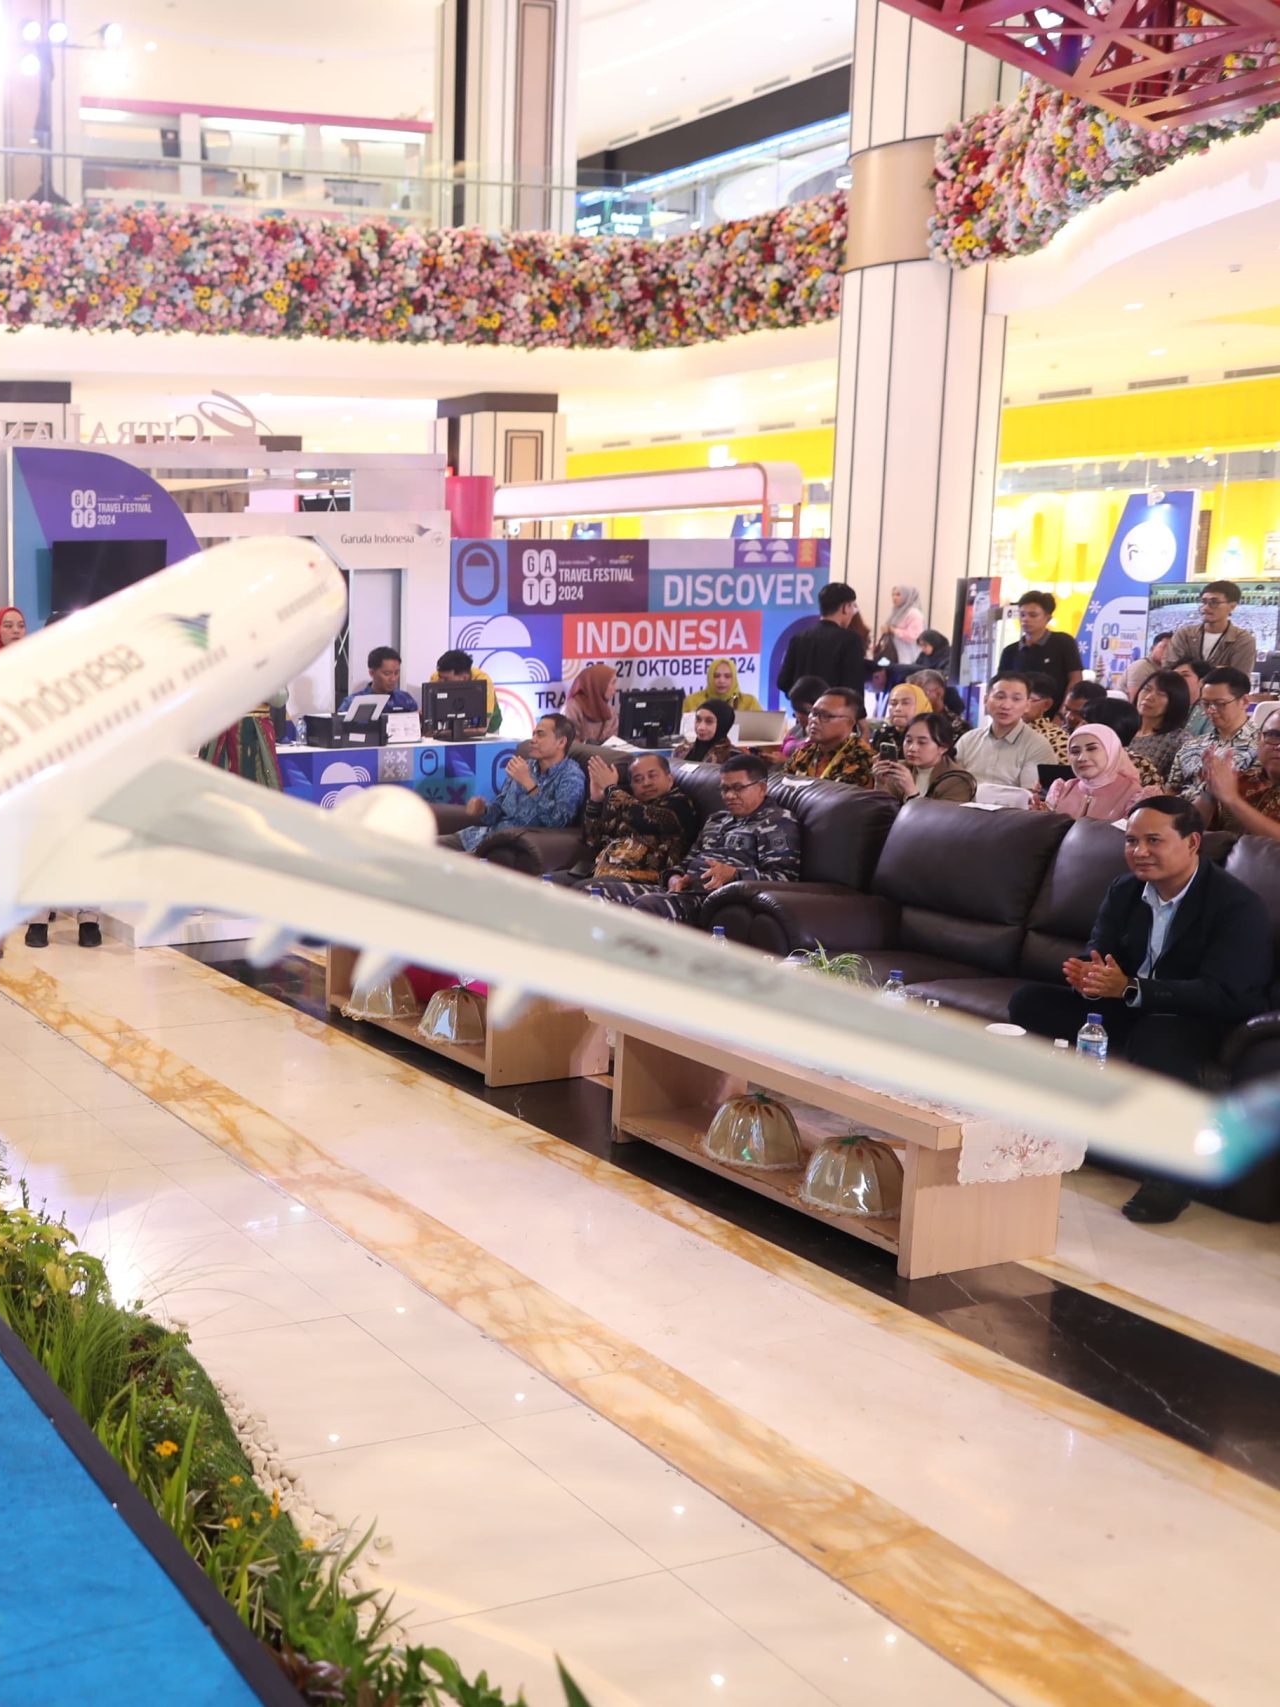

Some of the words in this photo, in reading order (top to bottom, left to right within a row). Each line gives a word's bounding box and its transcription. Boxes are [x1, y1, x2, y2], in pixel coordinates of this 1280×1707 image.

[97, 503, 122, 513] TRAVEL
[122, 503, 152, 513] FESTIVAL
[97, 515, 116, 525] 2024
[340, 534, 372, 544] Garuda
[374, 533, 415, 544] Indonesia
[558, 568, 592, 582] TRAVEL
[593, 568, 634, 582] FESTIVAL
[558, 586, 583, 600] 2024
[663, 573, 815, 607] DISCOVER
[576, 618, 748, 654] INDONESIA
[615, 661, 632, 677] 27
[1, 643, 145, 733] Indonesia
[535, 691, 567, 709] TRA
